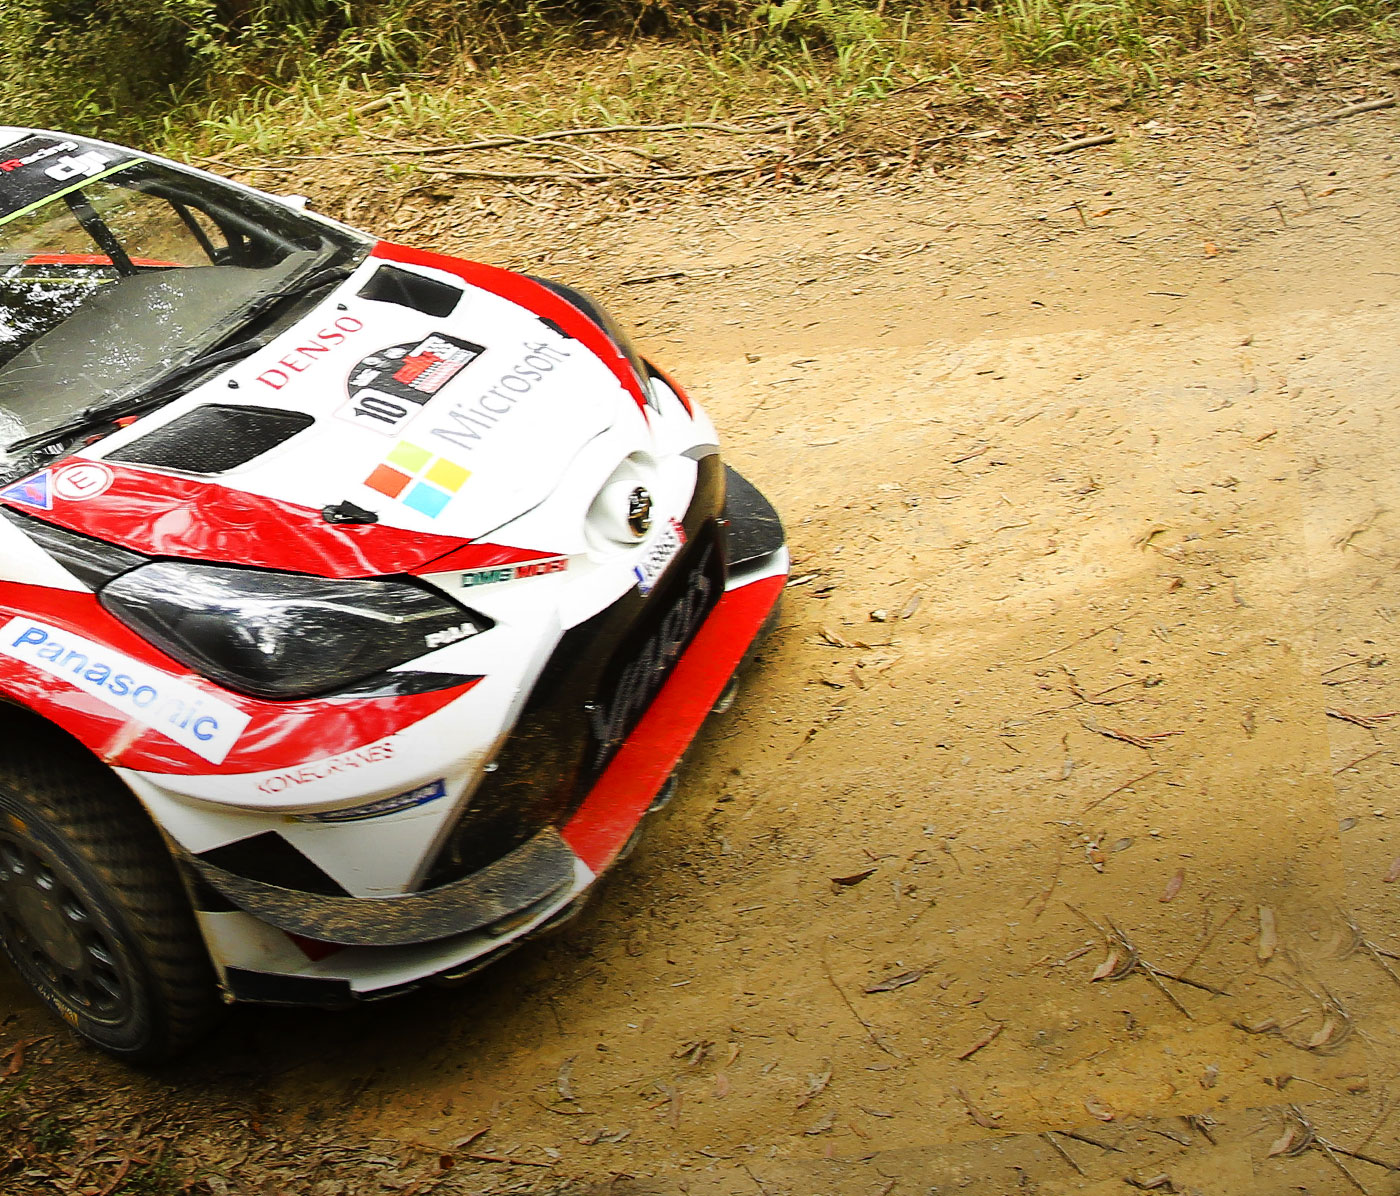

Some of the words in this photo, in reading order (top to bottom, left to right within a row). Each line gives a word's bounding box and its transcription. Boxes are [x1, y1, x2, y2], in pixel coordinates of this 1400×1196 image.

[0, 140, 80, 173] Racing
[255, 316, 364, 390] DENSO
[353, 396, 408, 425] 10
[430, 341, 572, 451] Microsoft
[67, 470, 97, 490] E
[11, 626, 219, 742] Panasonic
